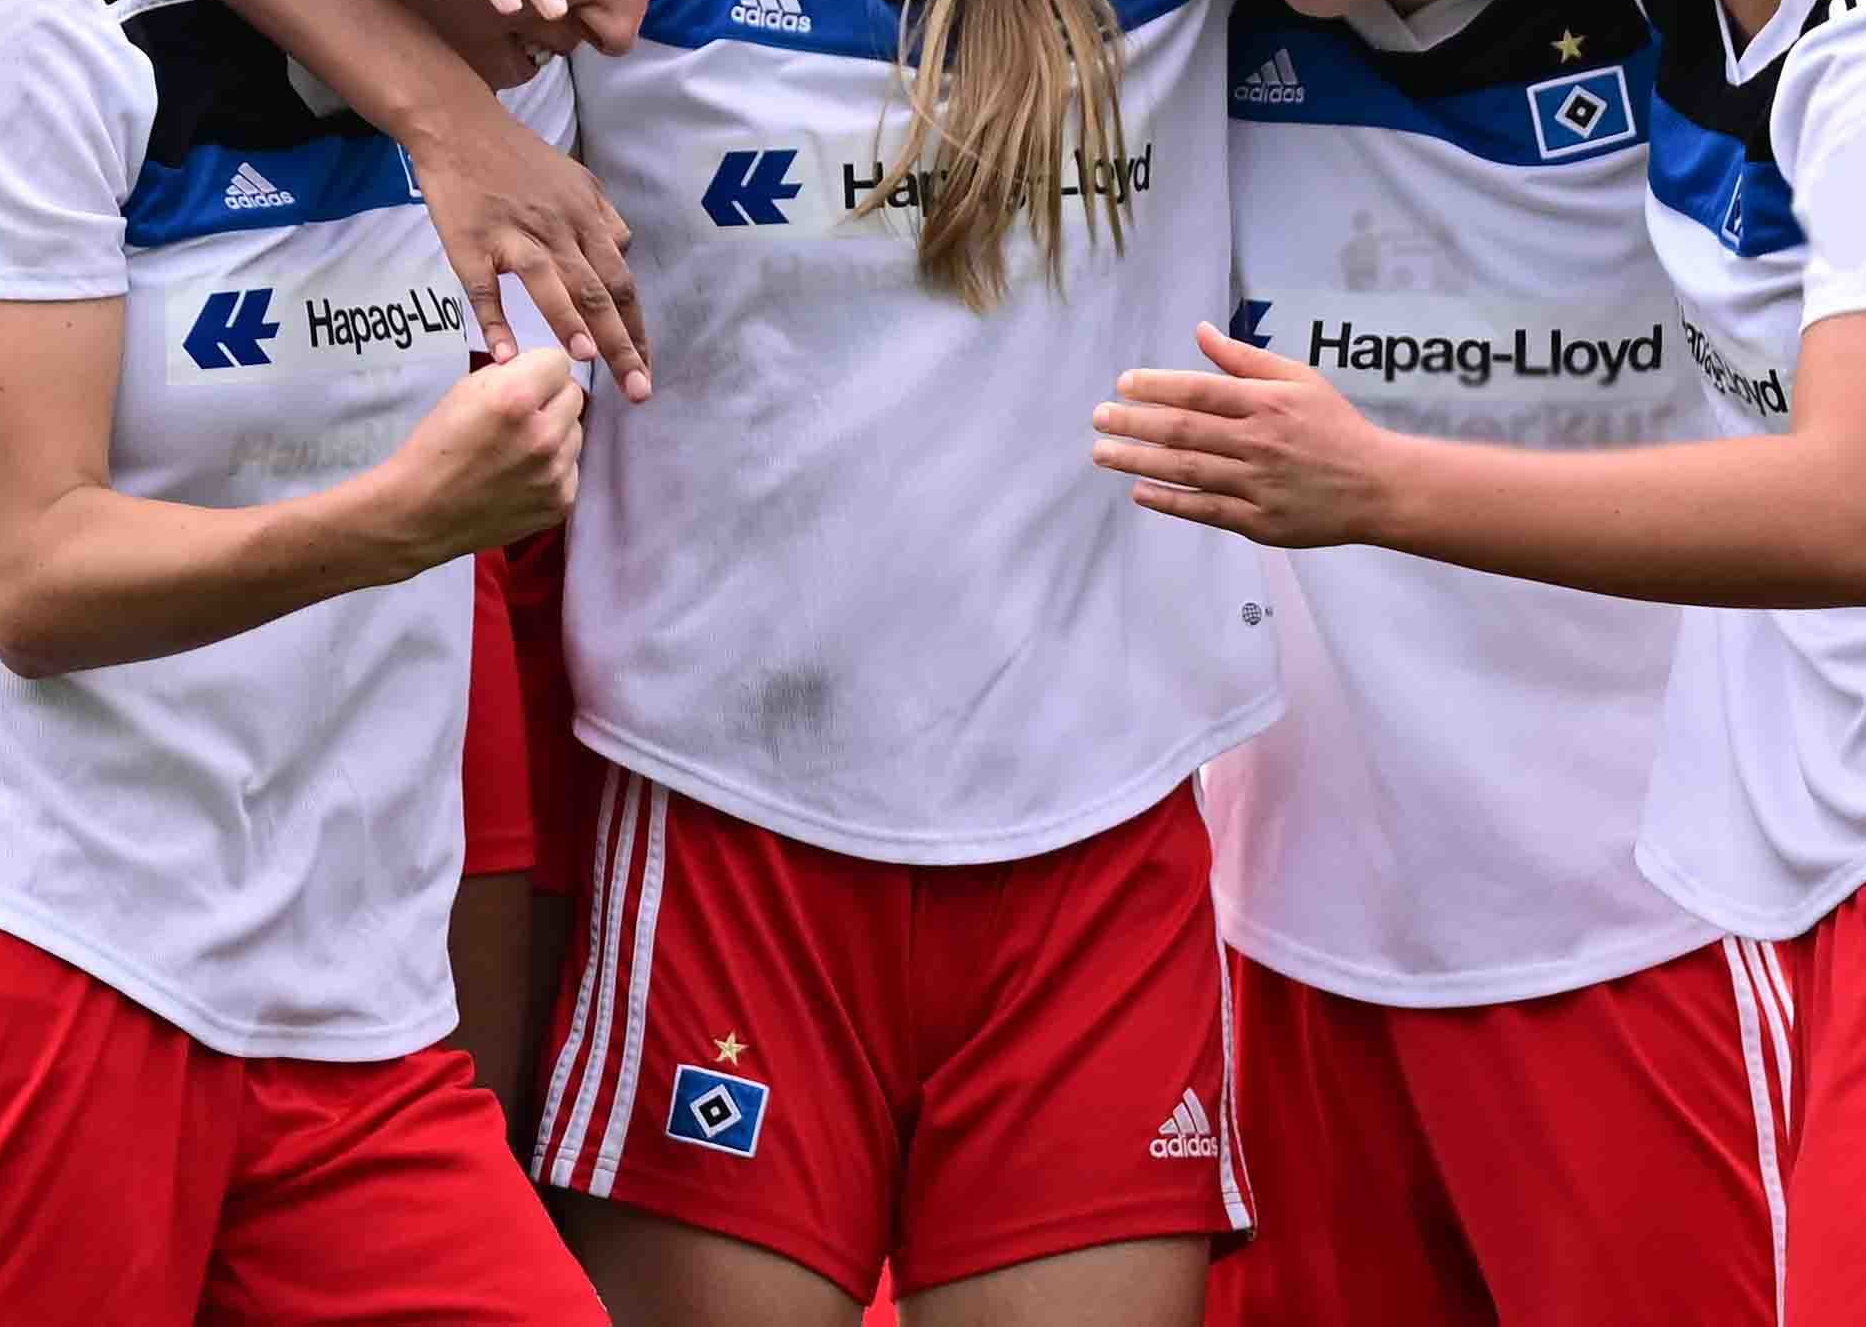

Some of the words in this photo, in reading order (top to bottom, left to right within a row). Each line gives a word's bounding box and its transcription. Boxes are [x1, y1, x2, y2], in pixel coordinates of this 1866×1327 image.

[730, 5, 812, 33] adidas
[1234, 82, 1305, 103] adidas
[224, 190, 295, 210] adidas
[306, 287, 468, 355] Hapag-Lloy
[1308, 320, 1663, 387] Hapag-Lloyd
[1149, 1132, 1218, 1159] adidas
